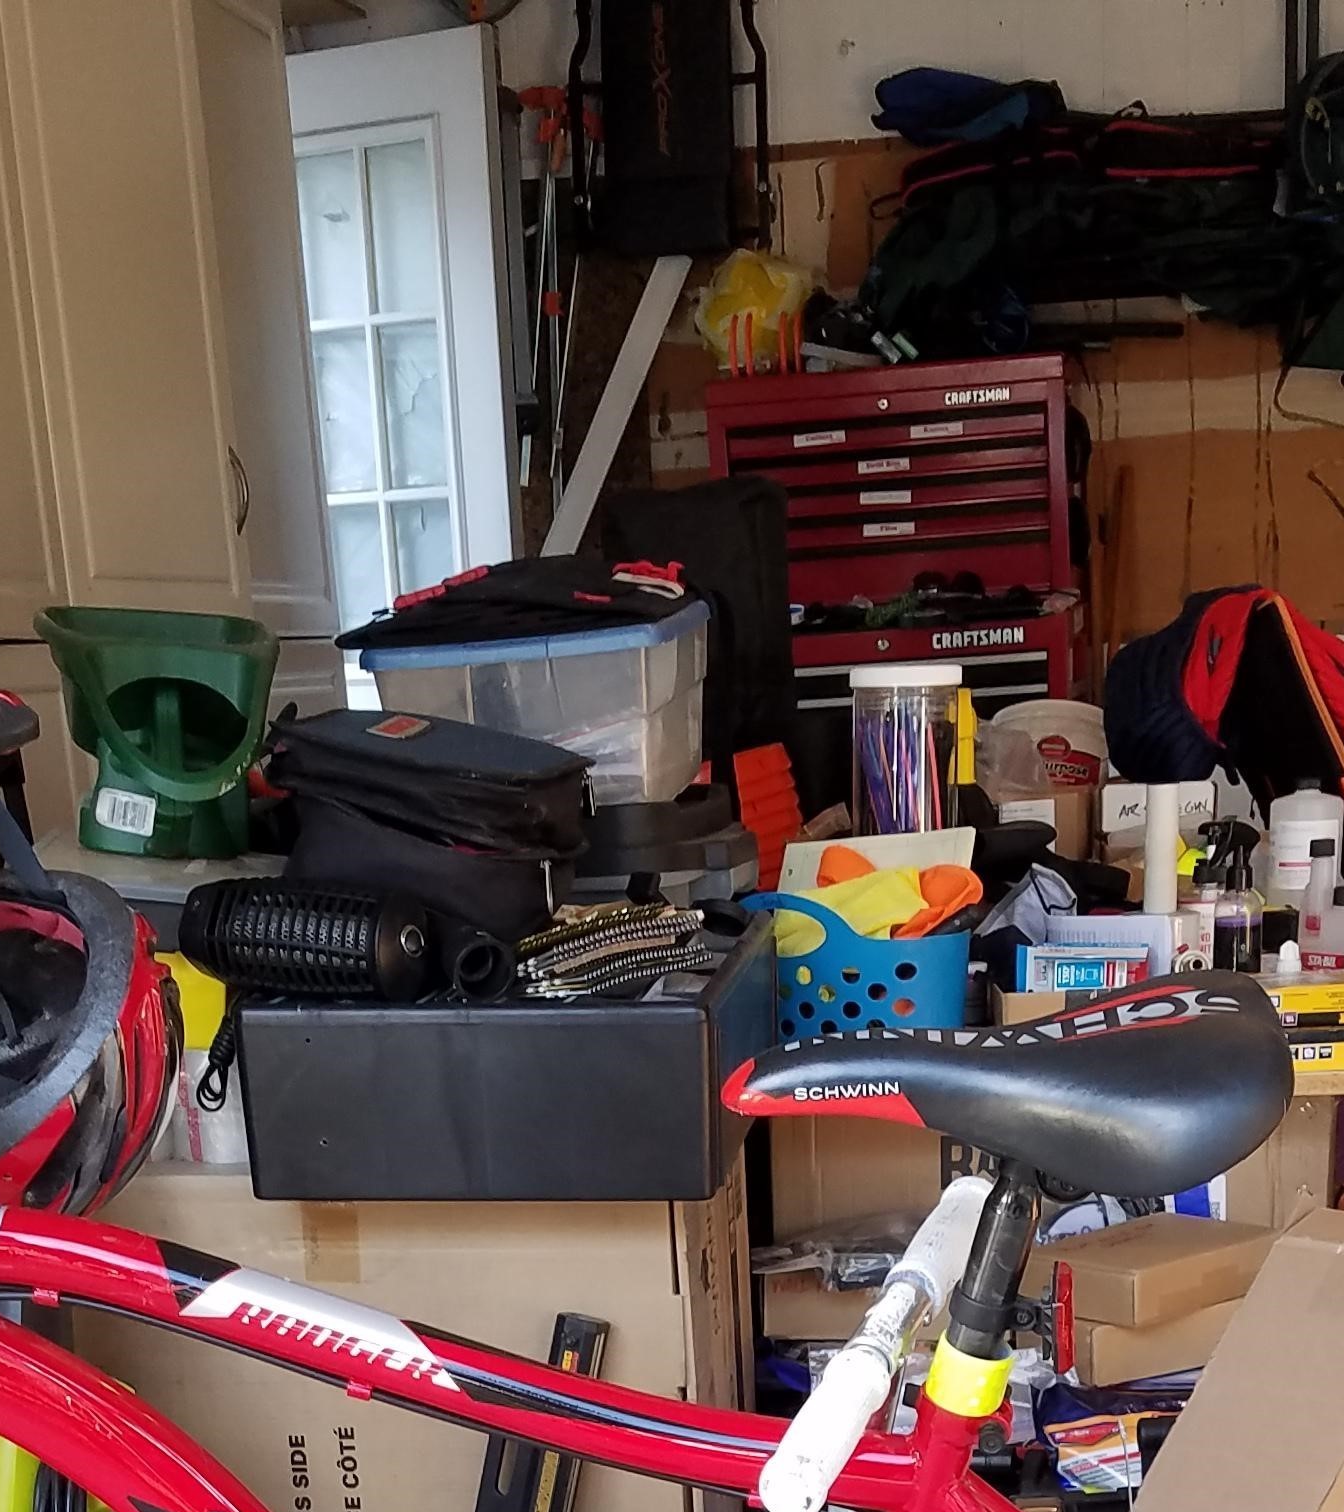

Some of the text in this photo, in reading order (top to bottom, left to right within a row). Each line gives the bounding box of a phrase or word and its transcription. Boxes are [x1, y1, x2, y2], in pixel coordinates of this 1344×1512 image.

[944, 387, 1010, 405] CRAFTSMAN
[932, 626, 1024, 649] CRAFTSMAN
[793, 1081, 900, 1102] SCHWINN
[289, 1435, 310, 1489] SIDE
[333, 1426, 360, 1489] CÔTÉ
